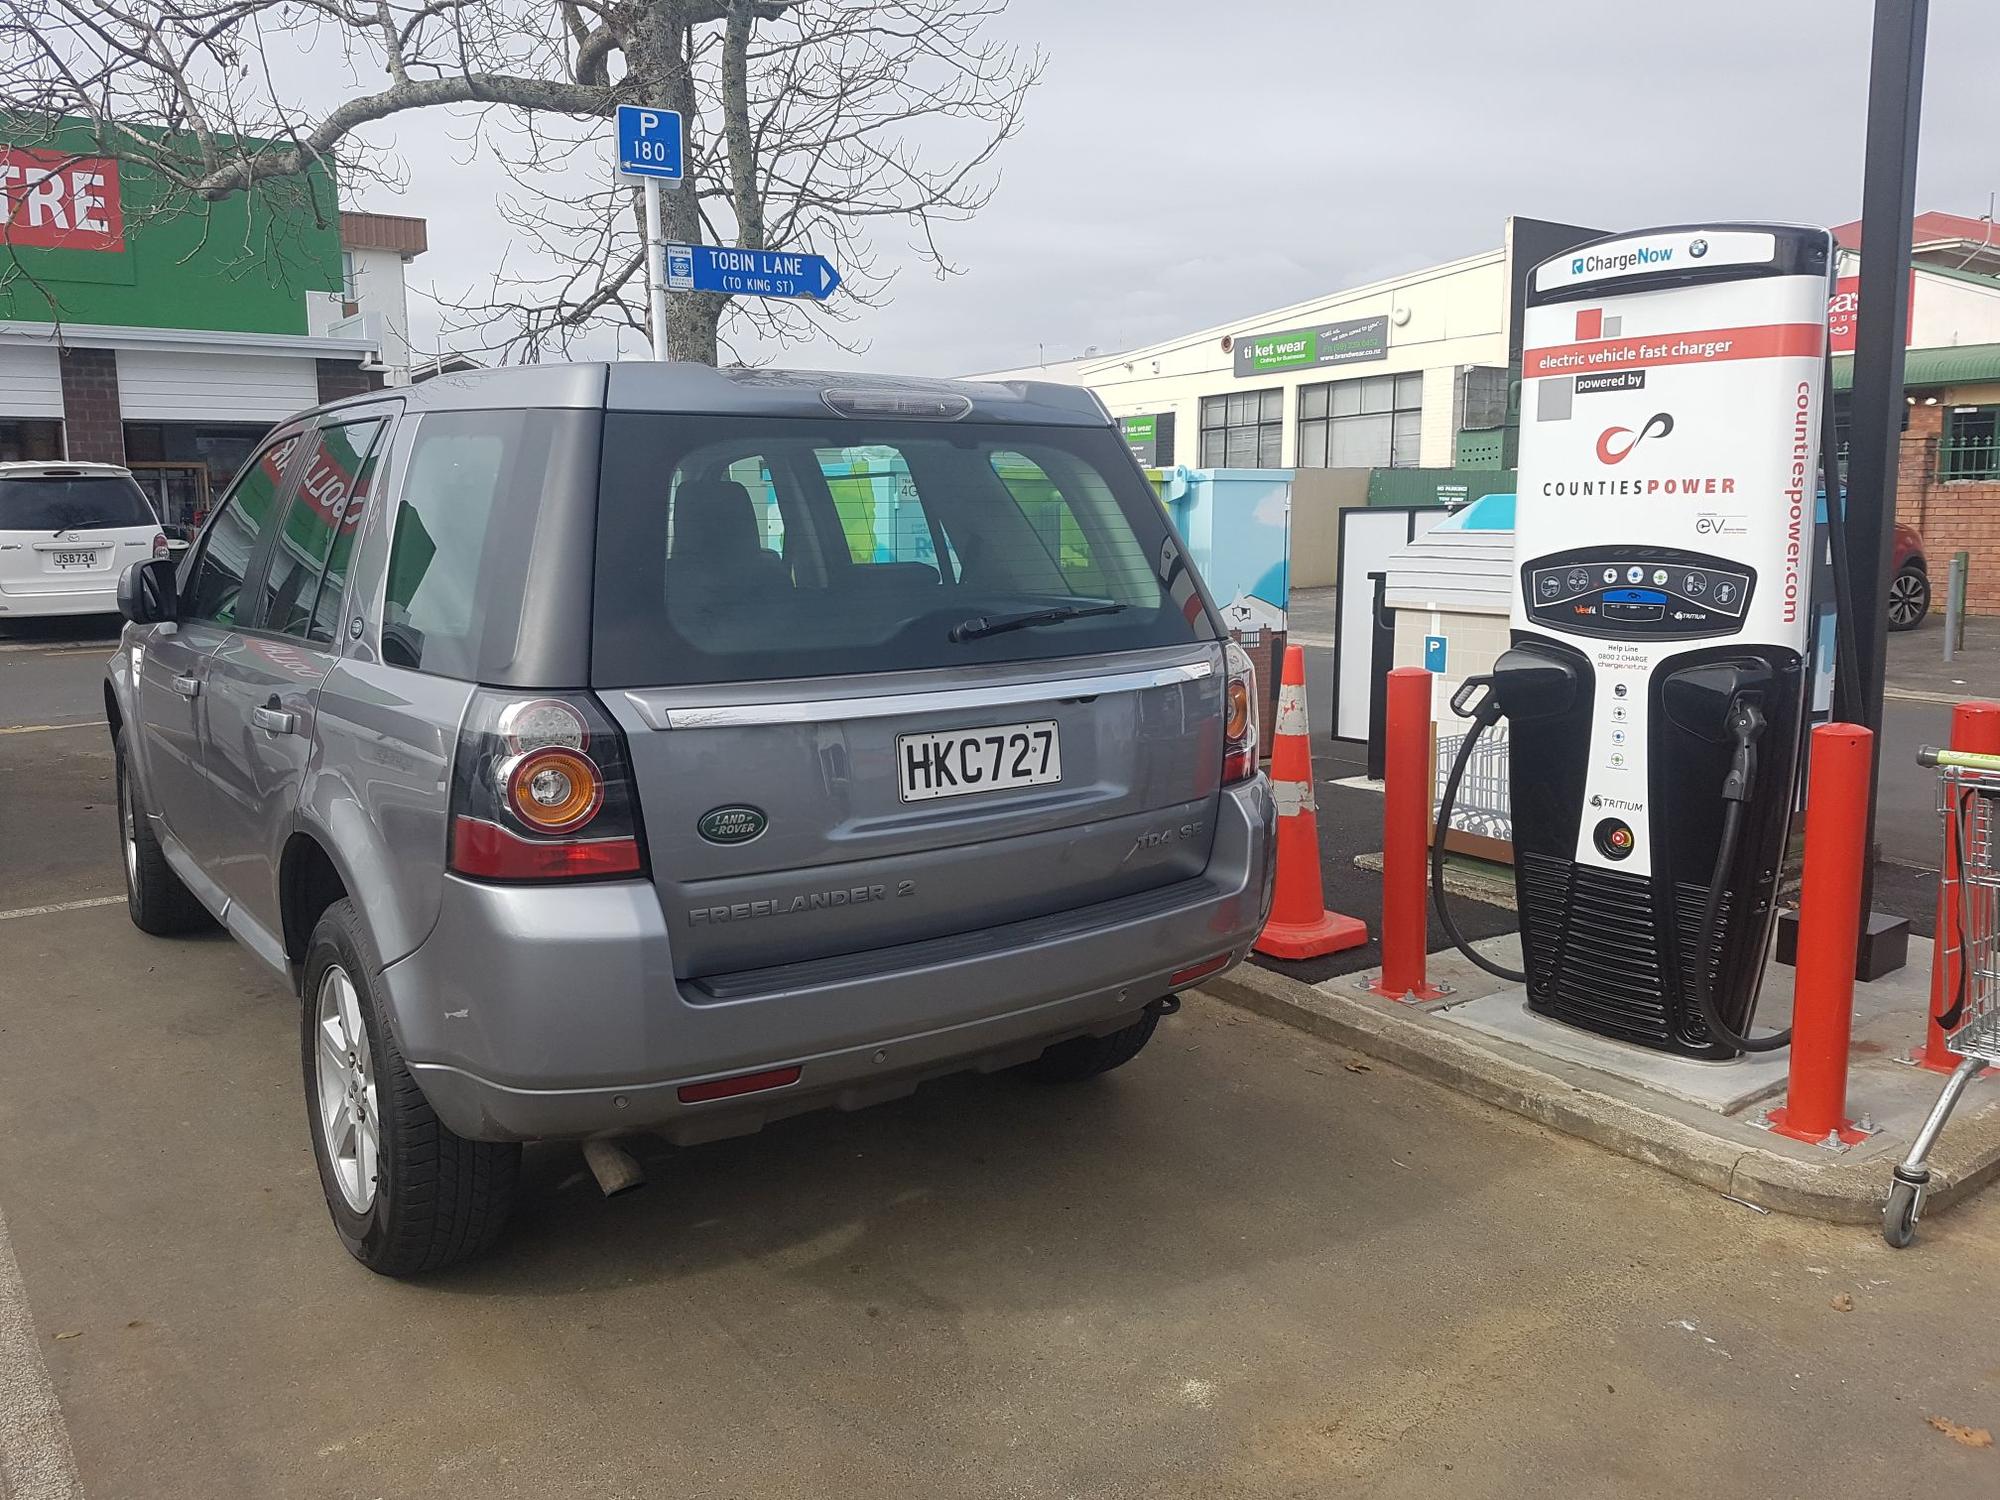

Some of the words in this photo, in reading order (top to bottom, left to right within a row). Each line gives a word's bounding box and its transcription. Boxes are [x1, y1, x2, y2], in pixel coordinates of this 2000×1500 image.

[640, 112, 659, 137] P
[634, 140, 665, 162] 180
[709, 251, 756, 273] TOBIN
[763, 255, 804, 276] LANE
[1585, 247, 1674, 272] ChargeNow
[722, 275, 742, 291] (TO
[747, 279, 772, 293] KING
[776, 280, 796, 296] ST)
[1255, 343, 1274, 357] ket
[1276, 340, 1307, 354] wear
[1539, 351, 1585, 369] electric
[1588, 347, 1636, 364] vehicle
[1639, 344, 1668, 359] fast
[1672, 339, 1733, 357] charger
[1577, 376, 1625, 391] powered
[1627, 373, 1642, 388] by
[1543, 478, 1735, 497] COUNTIESPOWER
[1783, 381, 1810, 623] countiespower.com
[56, 552, 95, 564] JSB734
[1429, 641, 1440, 652] P
[1607, 644, 1623, 652] Help
[1616, 653, 1620, 661] 2
[1621, 655, 1648, 663] CHARGE
[905, 729, 1053, 791] HKC727
[1603, 797, 1643, 812] TRITIUM
[688, 884, 887, 928] FREELANDER
[897, 879, 916, 897] 2
